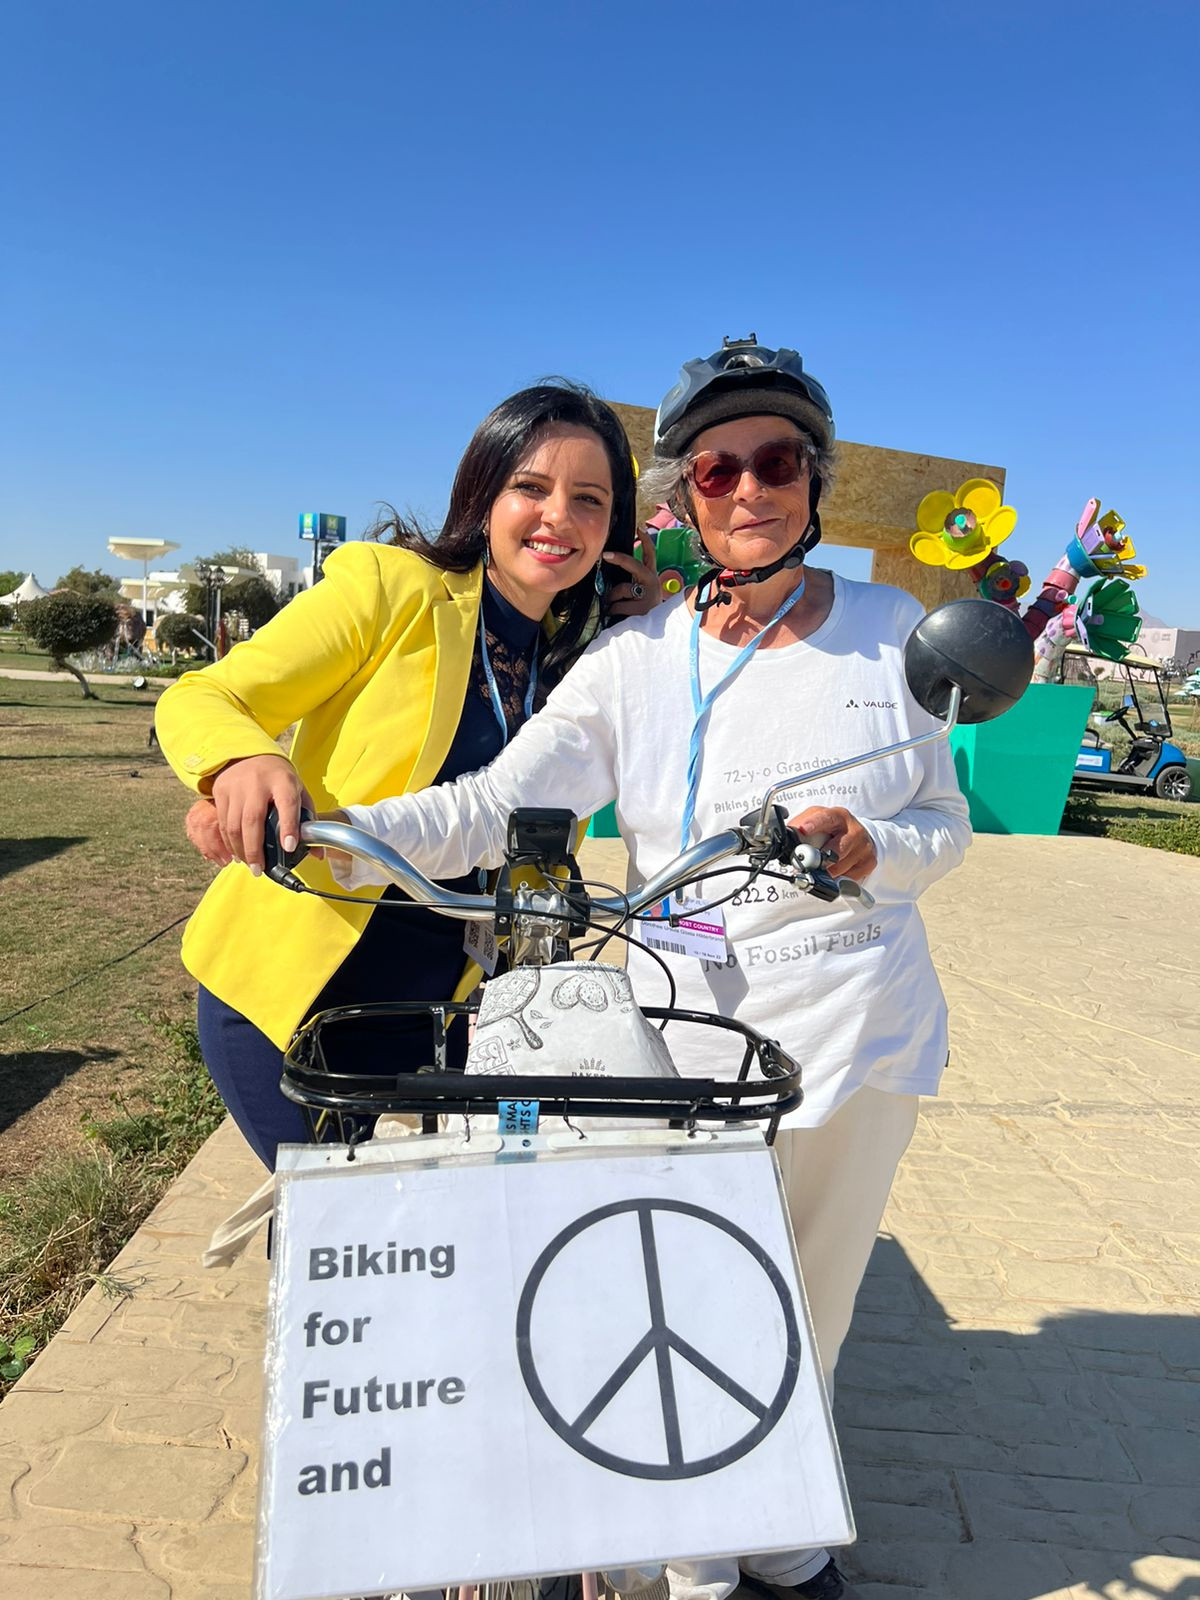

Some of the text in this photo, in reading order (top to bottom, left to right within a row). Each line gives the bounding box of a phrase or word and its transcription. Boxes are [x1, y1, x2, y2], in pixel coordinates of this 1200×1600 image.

[863, 700, 899, 710] VAUDE
[773, 789, 805, 803] uture
[806, 784, 828, 797] and
[830, 784, 858, 796] Peace
[782, 889, 799, 900] km
[693, 923, 720, 933] COUNTRY
[745, 935, 818, 967] Fossil
[825, 923, 881, 952] Fuels
[308, 1241, 455, 1281] Biking
[304, 1311, 372, 1347] for
[302, 1375, 466, 1419] Future
[297, 1446, 391, 1496] and
